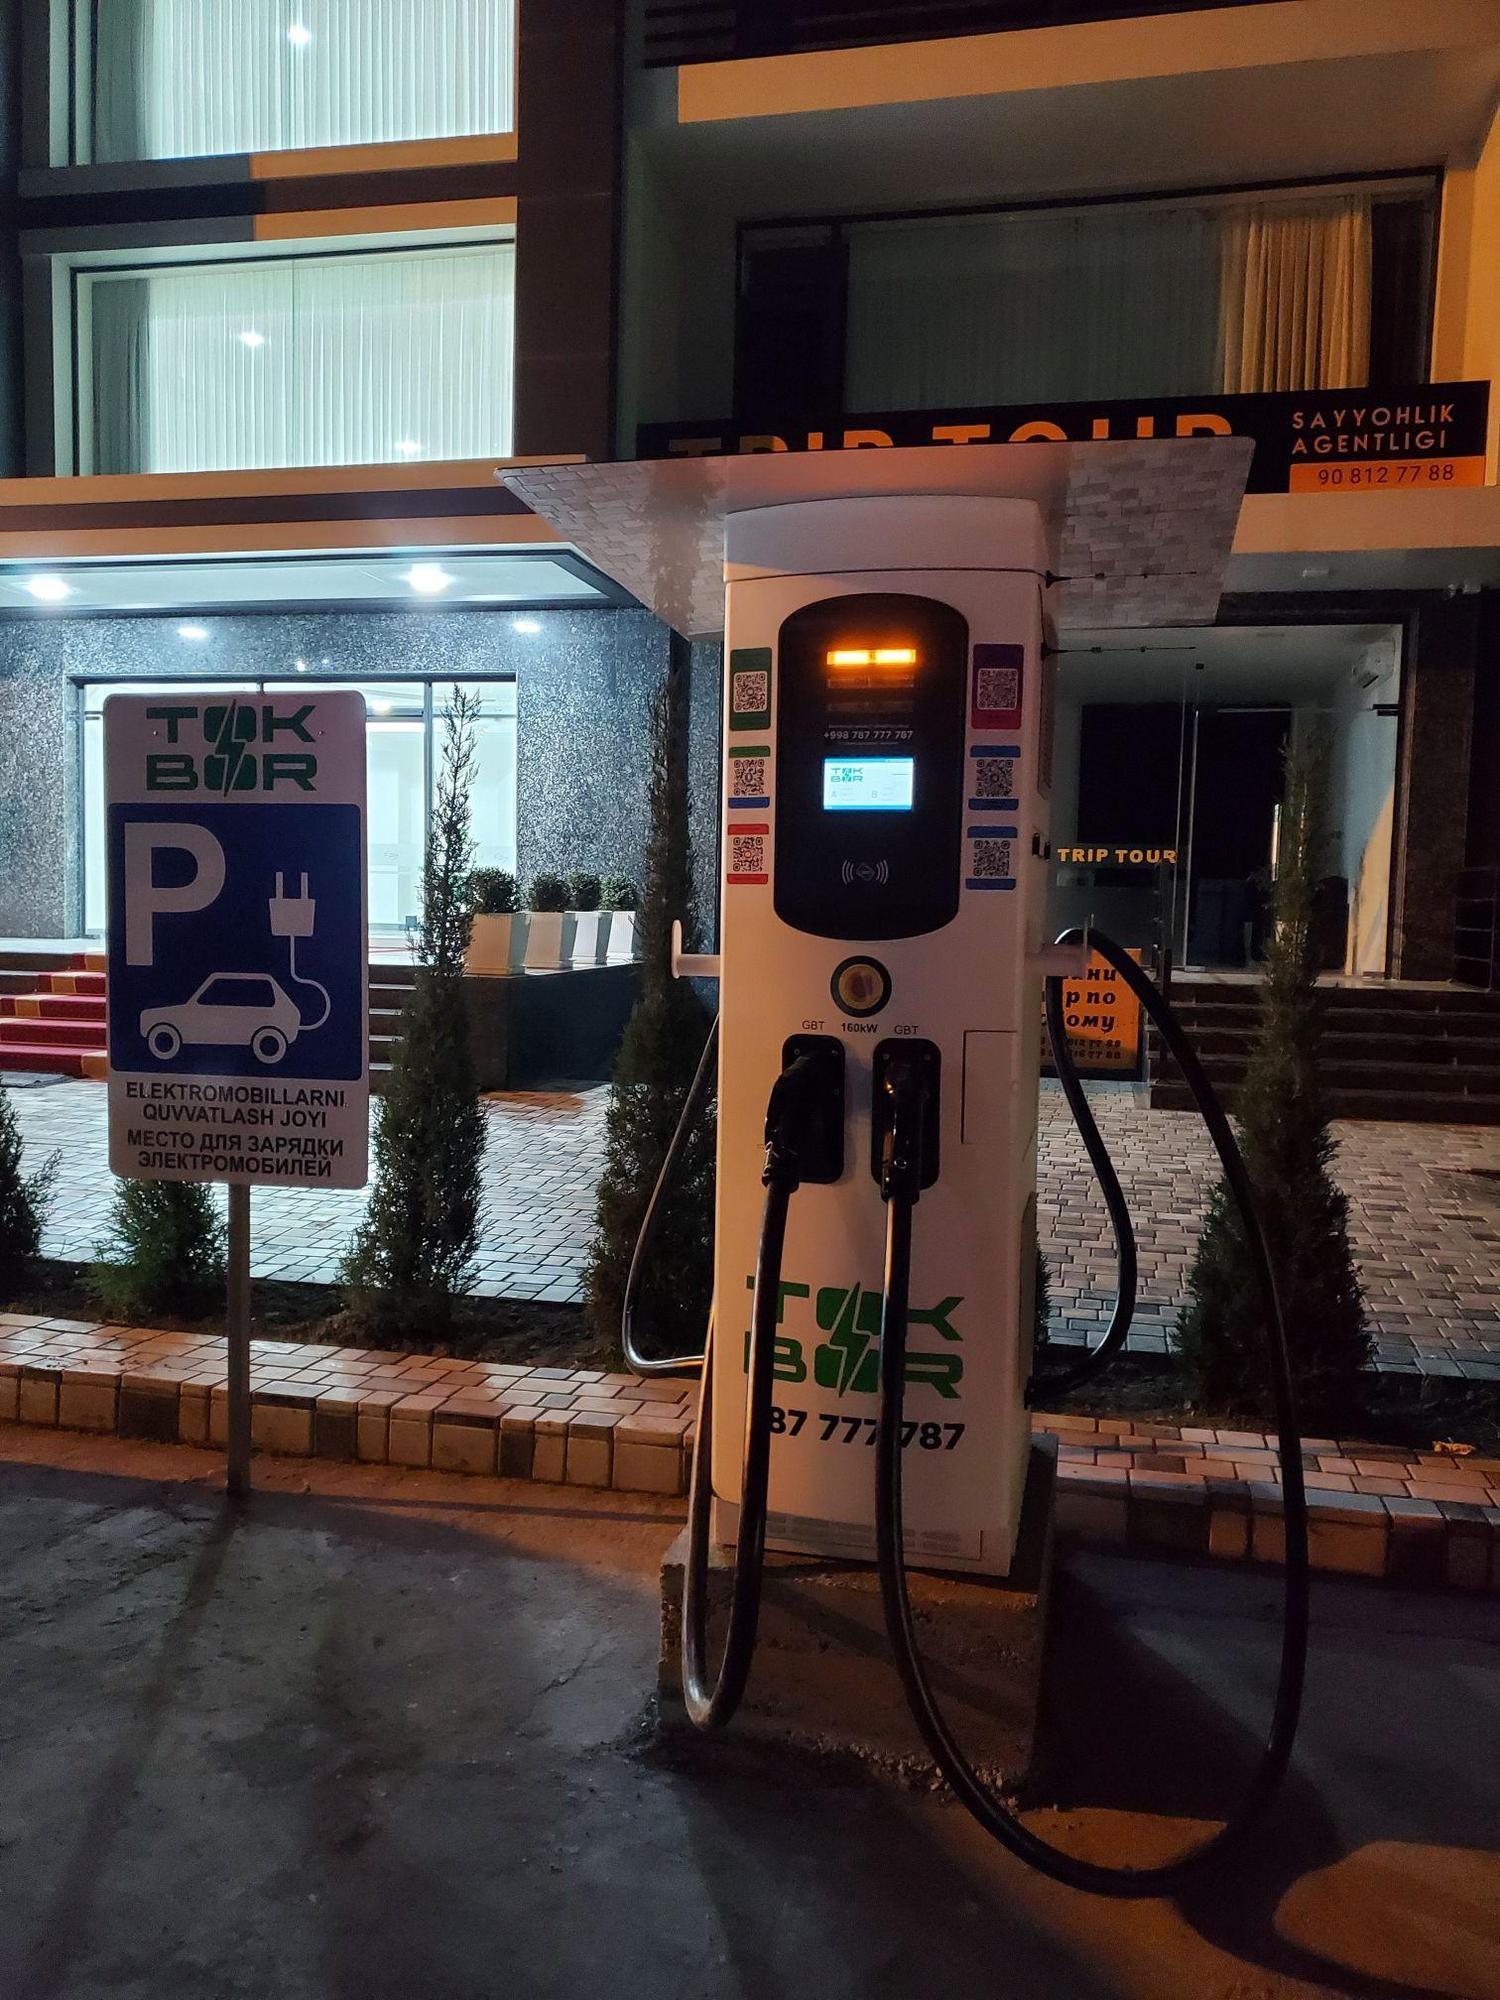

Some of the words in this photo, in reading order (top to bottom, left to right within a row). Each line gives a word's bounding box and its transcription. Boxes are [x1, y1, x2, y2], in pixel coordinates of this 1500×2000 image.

[1292, 404, 1455, 429] SAYYOHLIK
[1291, 430, 1446, 454] AGENTLIGI
[1318, 469, 1343, 485] 90
[1350, 466, 1388, 484] 812
[1396, 465, 1421, 482] 77
[1428, 464, 1454, 481] 88
[146, 704, 316, 744] TOK
[873, 730, 892, 740] 777
[146, 753, 318, 791] BOR
[1057, 848, 1109, 863] TRIP
[1115, 849, 1178, 864] TOUR
[124, 822, 226, 966] P
[801, 1020, 825, 1031] GBT
[841, 1022, 879, 1034] 160kW
[894, 1025, 919, 1036] GBT
[126, 1082, 345, 1107] ELEKTROMOBILLARNI
[143, 1103, 274, 1126] QUVVATLASH
[280, 1110, 326, 1128] JOYI
[127, 1129, 194, 1149] МЕСТО
[200, 1133, 241, 1152] ДЛЯ
[248, 1136, 344, 1157] ЗАРЯДКИ
[138, 1151, 332, 1177] ЭЛЕКТРОМОБИЛЕЙ
[900, 1421, 966, 1450] 787
